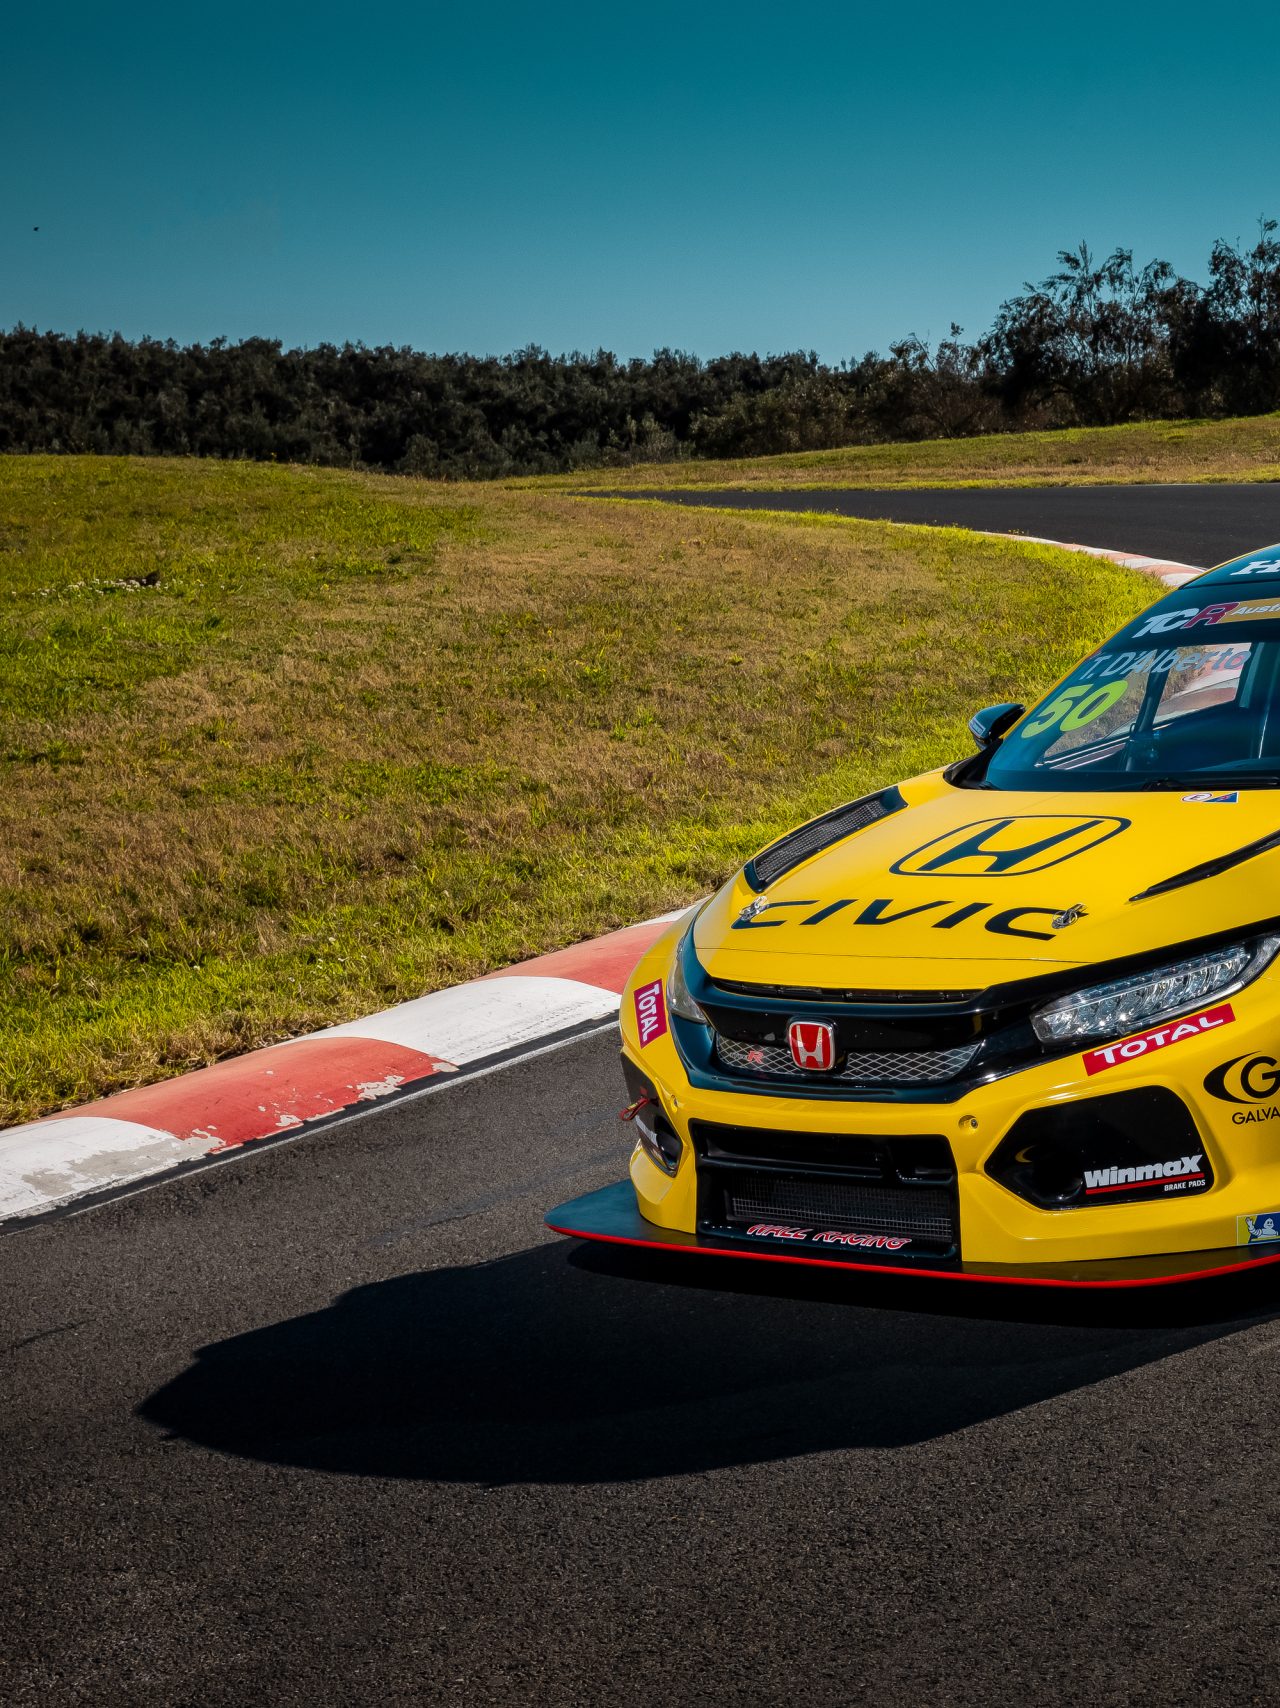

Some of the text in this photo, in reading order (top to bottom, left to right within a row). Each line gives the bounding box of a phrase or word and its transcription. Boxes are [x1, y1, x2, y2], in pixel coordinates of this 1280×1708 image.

[1132, 602, 1240, 638] TCR
[1079, 647, 1252, 681] T. D'Alberto
[1021, 680, 1128, 738] 50
[731, 898, 1089, 941] CIVIC
[638, 983, 660, 1042] TOTAL
[1094, 1016, 1224, 1064] TOTAL
[1163, 1178, 1206, 1192] BRAKE PADS
[747, 1223, 913, 1250] WALL RACING
